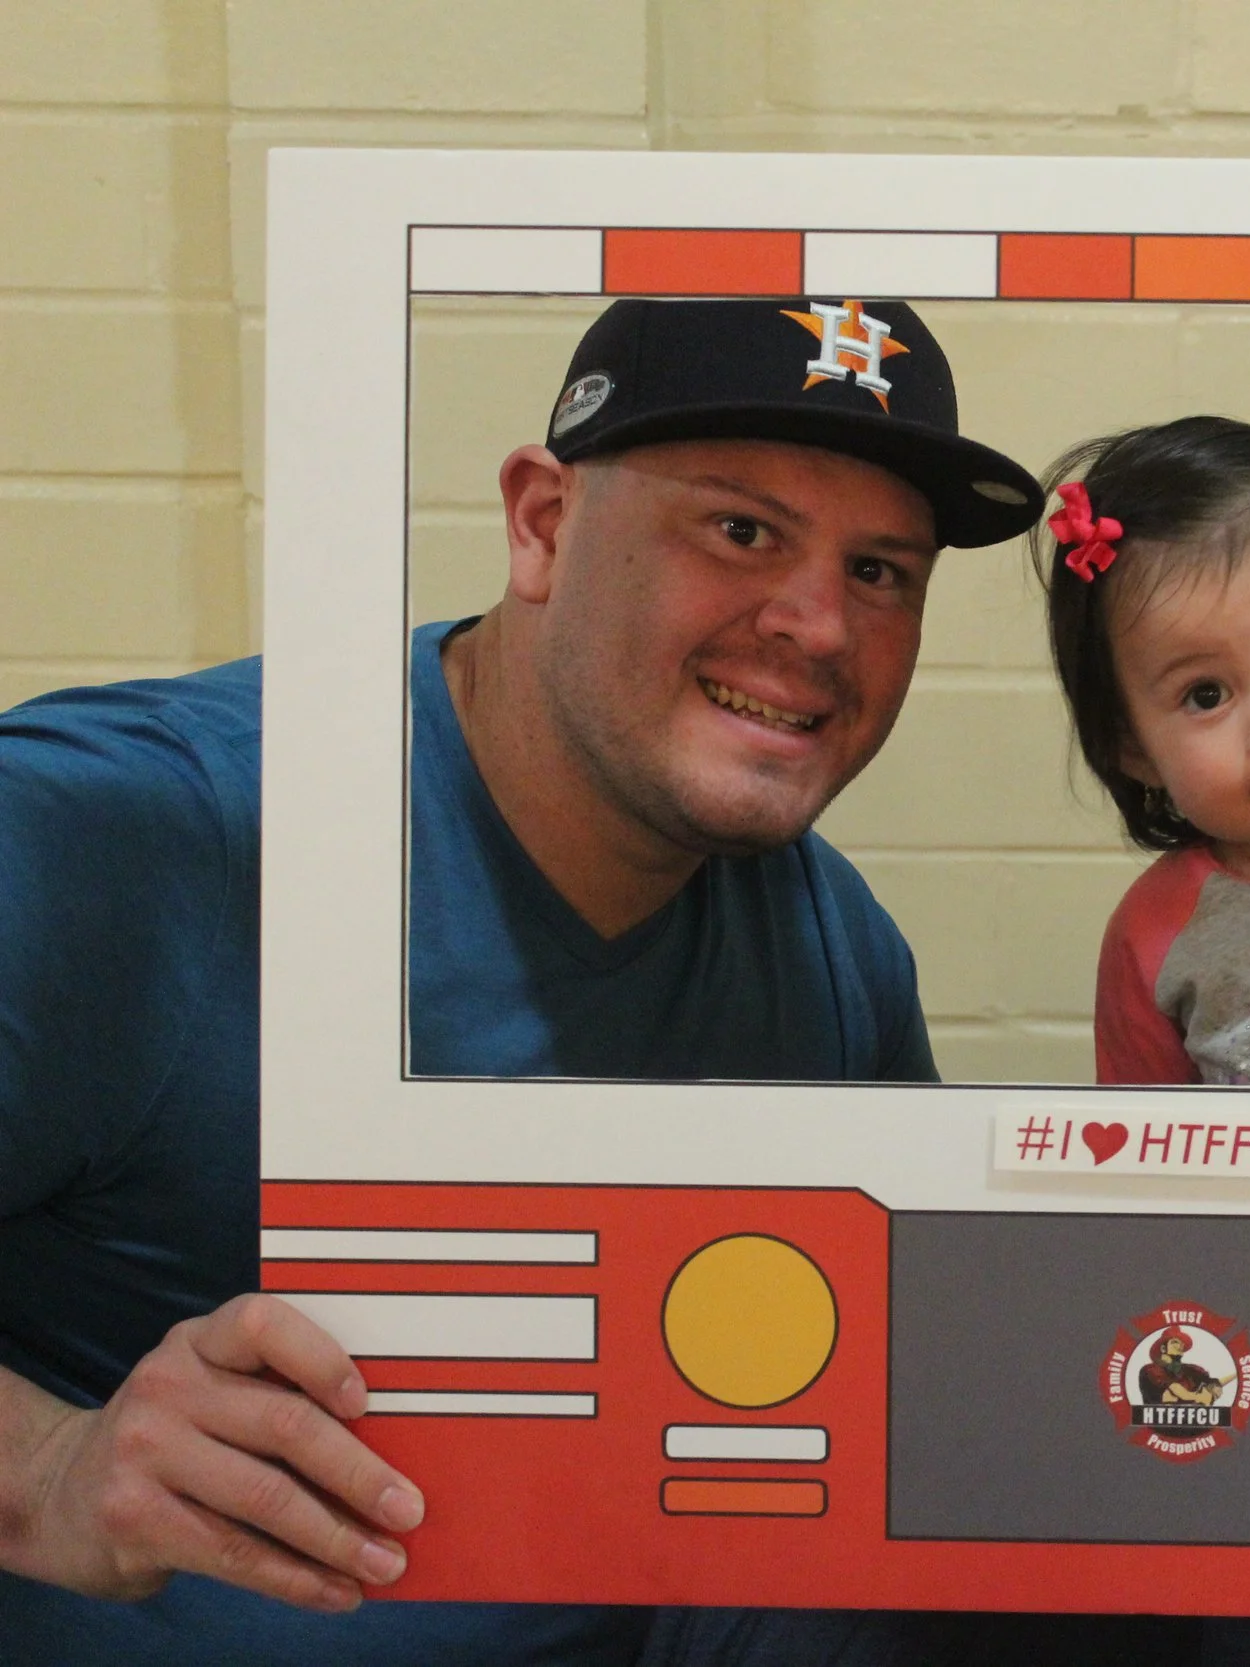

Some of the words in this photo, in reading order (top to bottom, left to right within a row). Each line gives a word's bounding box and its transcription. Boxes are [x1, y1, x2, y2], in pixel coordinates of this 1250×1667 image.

[806, 302, 892, 394] H
[1016, 1116, 1072, 1161] #I
[1162, 1309, 1203, 1324] Trust
[1108, 1351, 1126, 1403] Family
[1143, 1407, 1220, 1425] HTFFFCU
[1146, 1433, 1216, 1456] Prosperity
